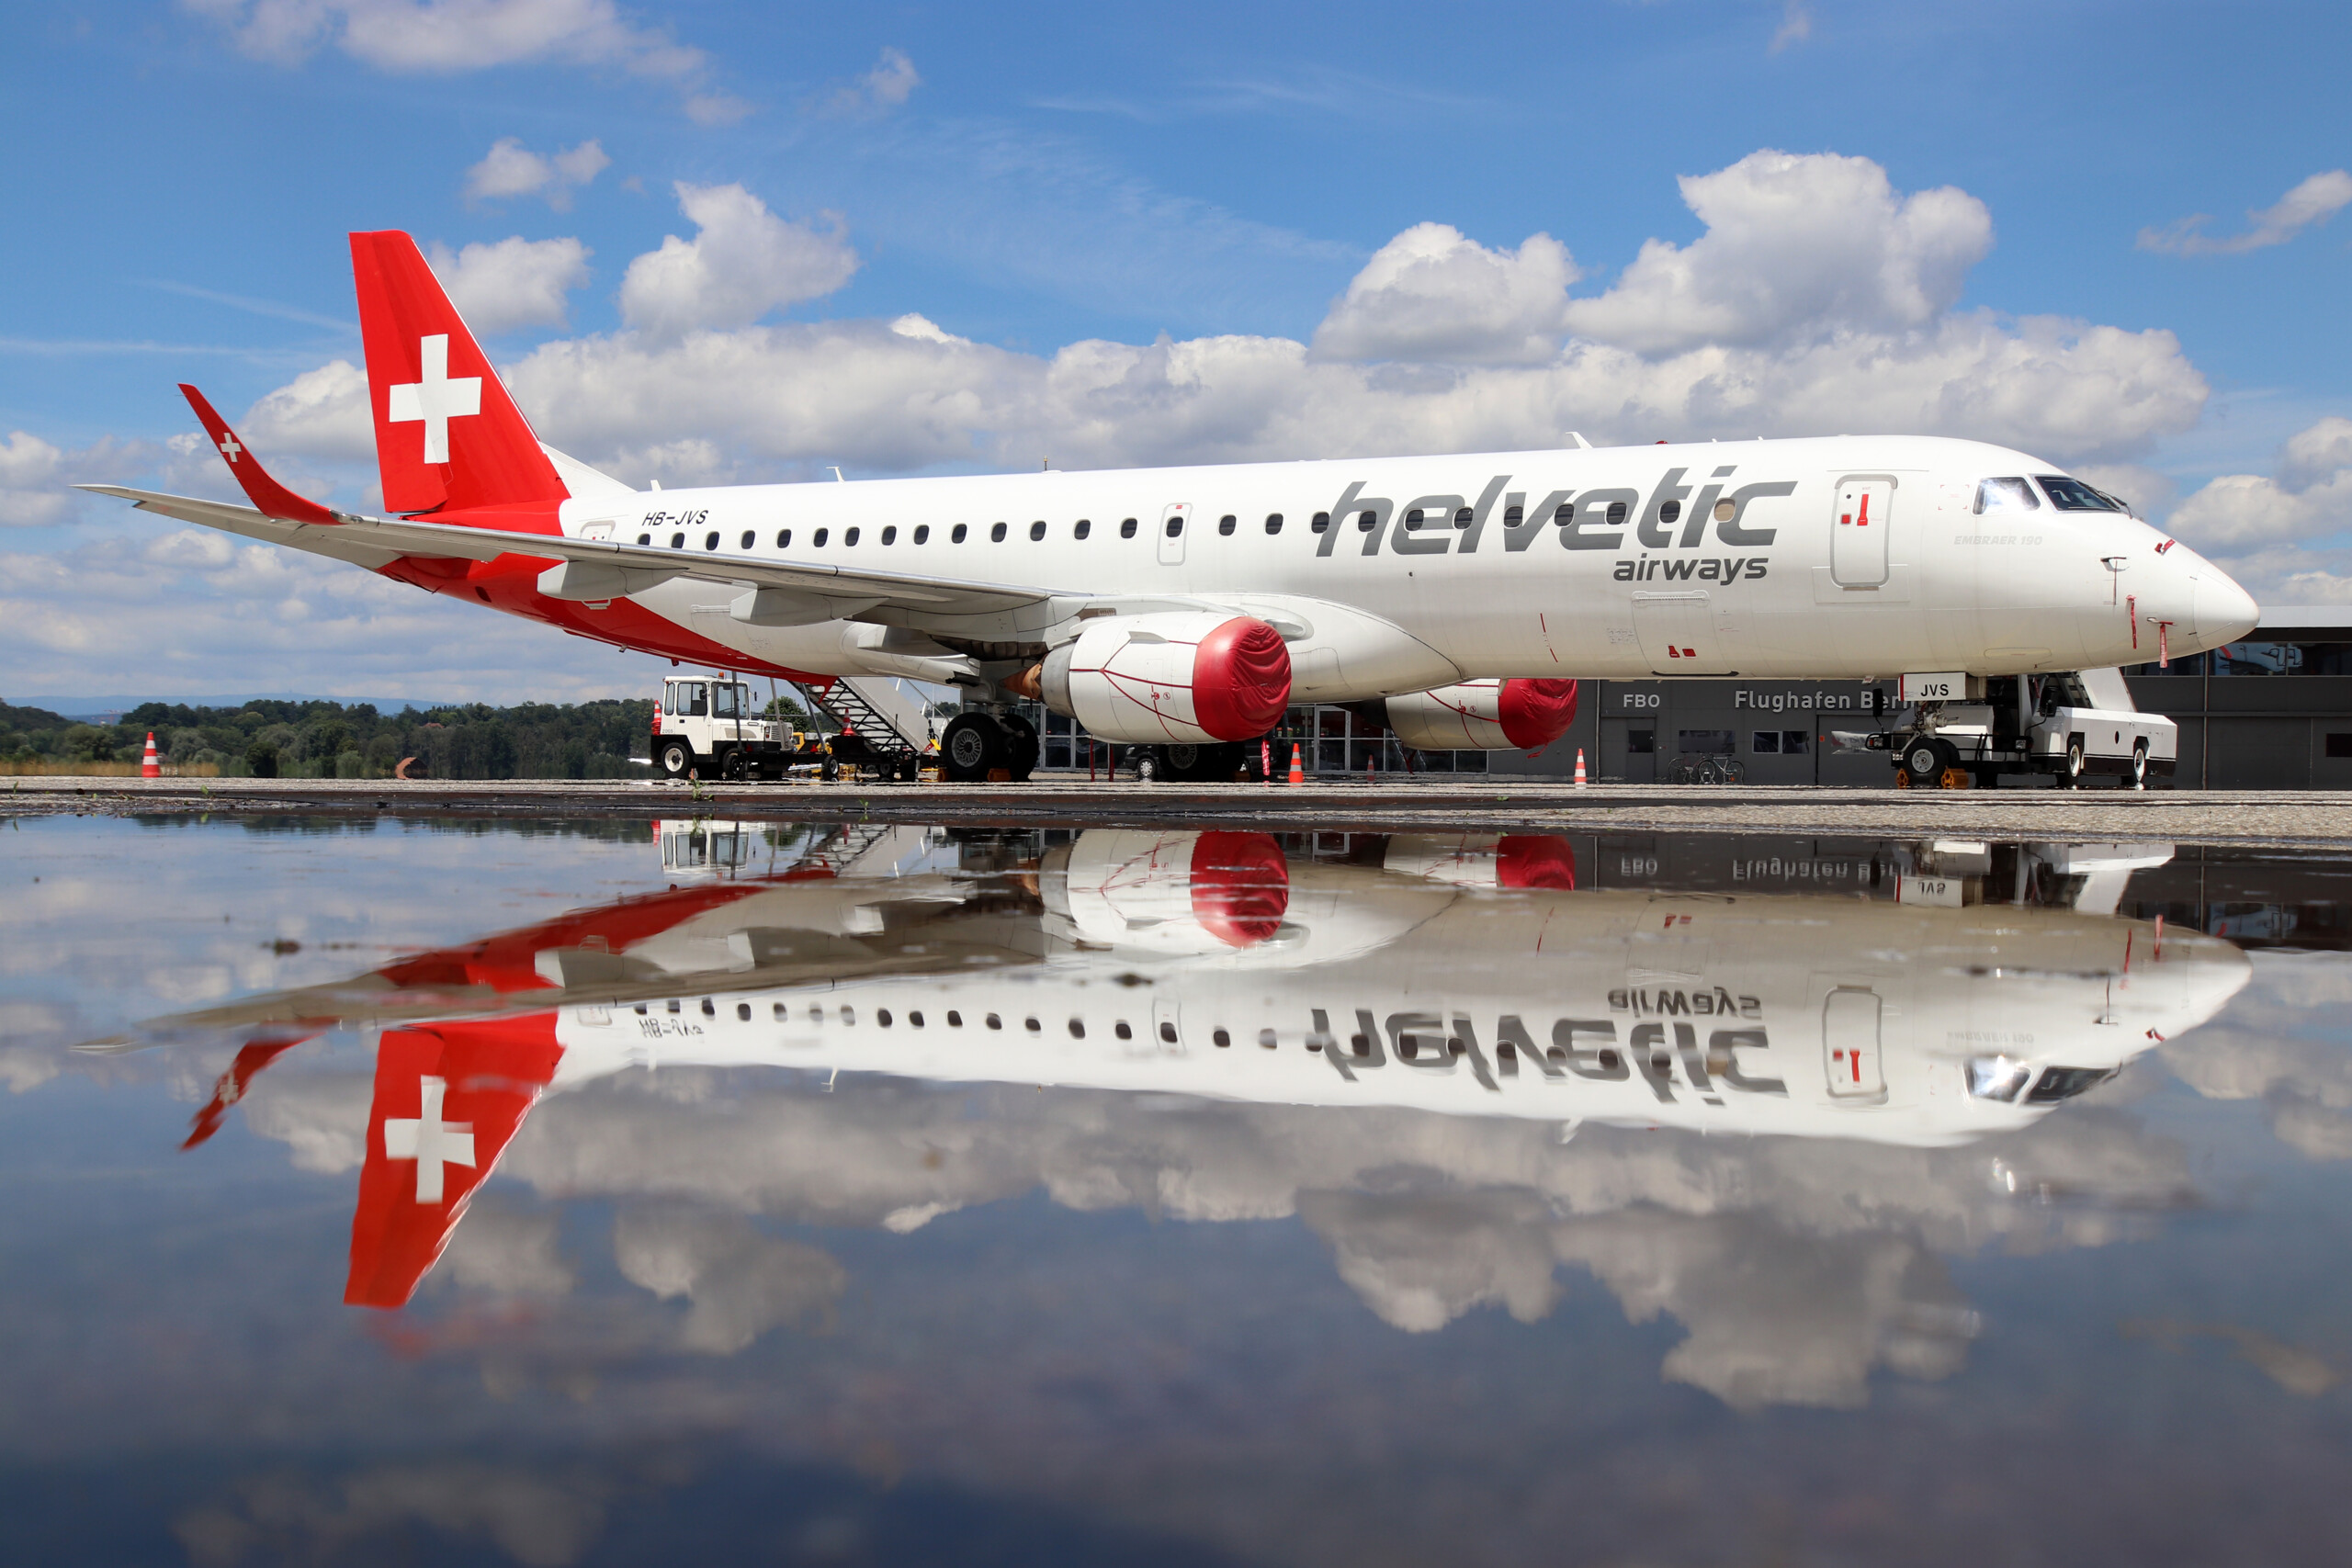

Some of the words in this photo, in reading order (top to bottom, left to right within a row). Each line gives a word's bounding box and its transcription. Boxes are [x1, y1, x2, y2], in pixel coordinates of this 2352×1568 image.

[641, 509, 709, 526] HB-JVS
[1316, 465, 1798, 556] helvetic
[1953, 535, 2018, 546] EMBRAER
[2020, 536, 2043, 546] 190
[1613, 554, 1769, 585] airways
[1920, 683, 1950, 697] JVS
[1623, 694, 1660, 708] FBO
[1735, 690, 1850, 713] Flughafen
